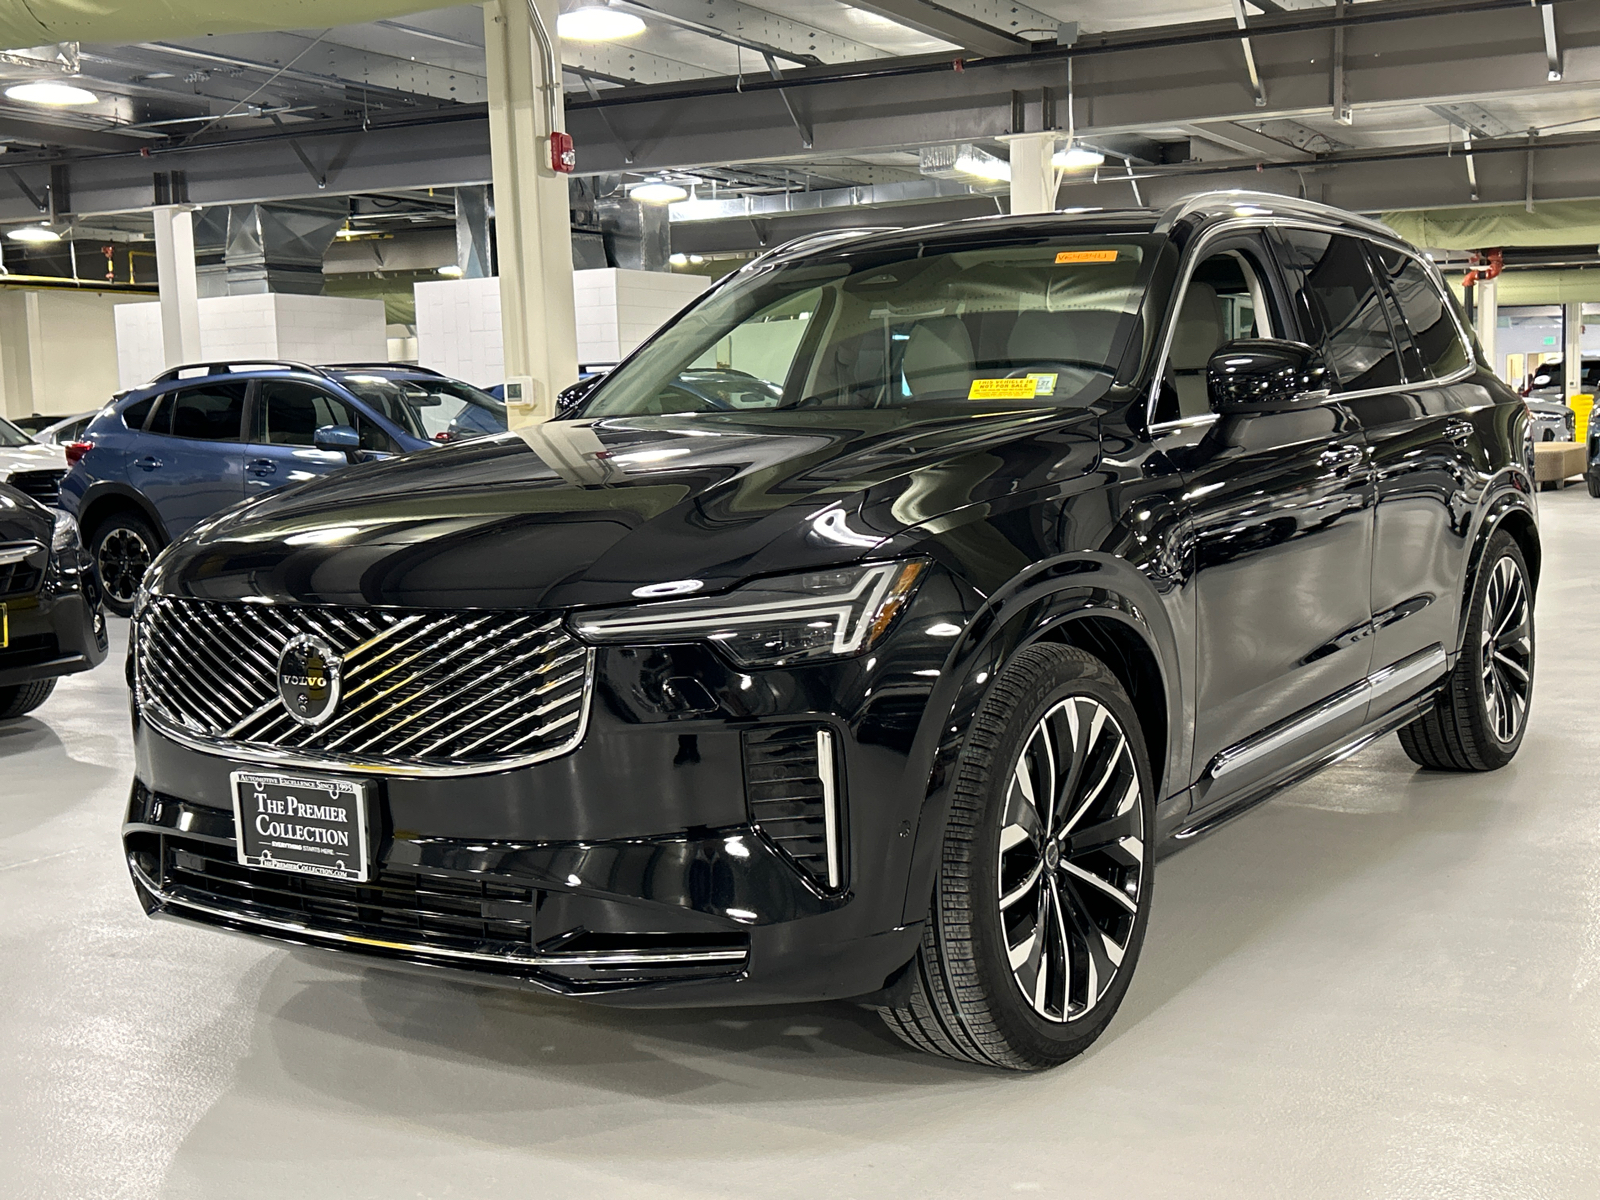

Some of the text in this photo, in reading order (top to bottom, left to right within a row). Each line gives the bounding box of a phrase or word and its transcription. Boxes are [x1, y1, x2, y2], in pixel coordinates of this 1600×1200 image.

[281, 674, 327, 687] VOLVO
[240, 774, 353, 792] AUTOMOTIVE EXCELLENCE SINCE 1995
[254, 792, 348, 822] THE PREMIER
[255, 814, 349, 847] COLLECTION
